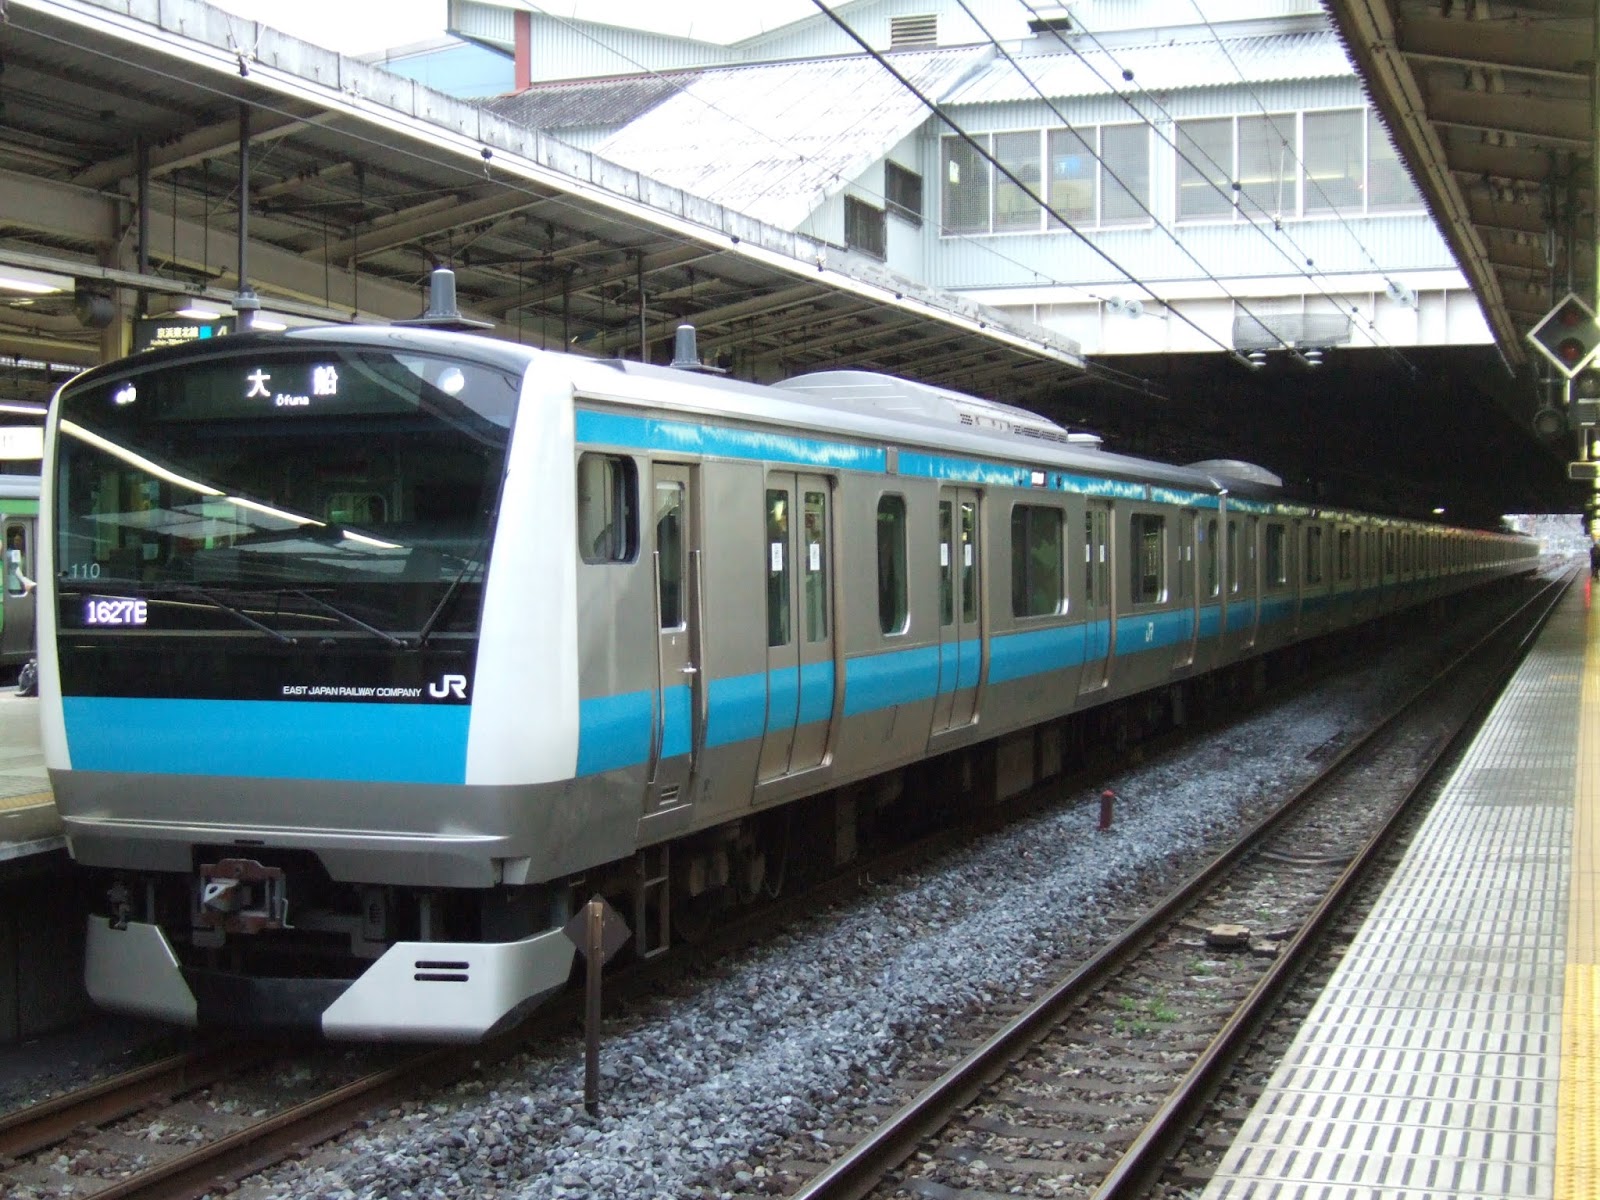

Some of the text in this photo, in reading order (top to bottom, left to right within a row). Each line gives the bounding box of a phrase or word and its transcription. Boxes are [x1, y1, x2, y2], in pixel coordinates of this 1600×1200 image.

[71, 563, 100, 579] 110
[88, 600, 148, 623] 1627E
[283, 686, 422, 698] EAST JAPAN RAILWAY COMPANY
[429, 674, 467, 699] JR
